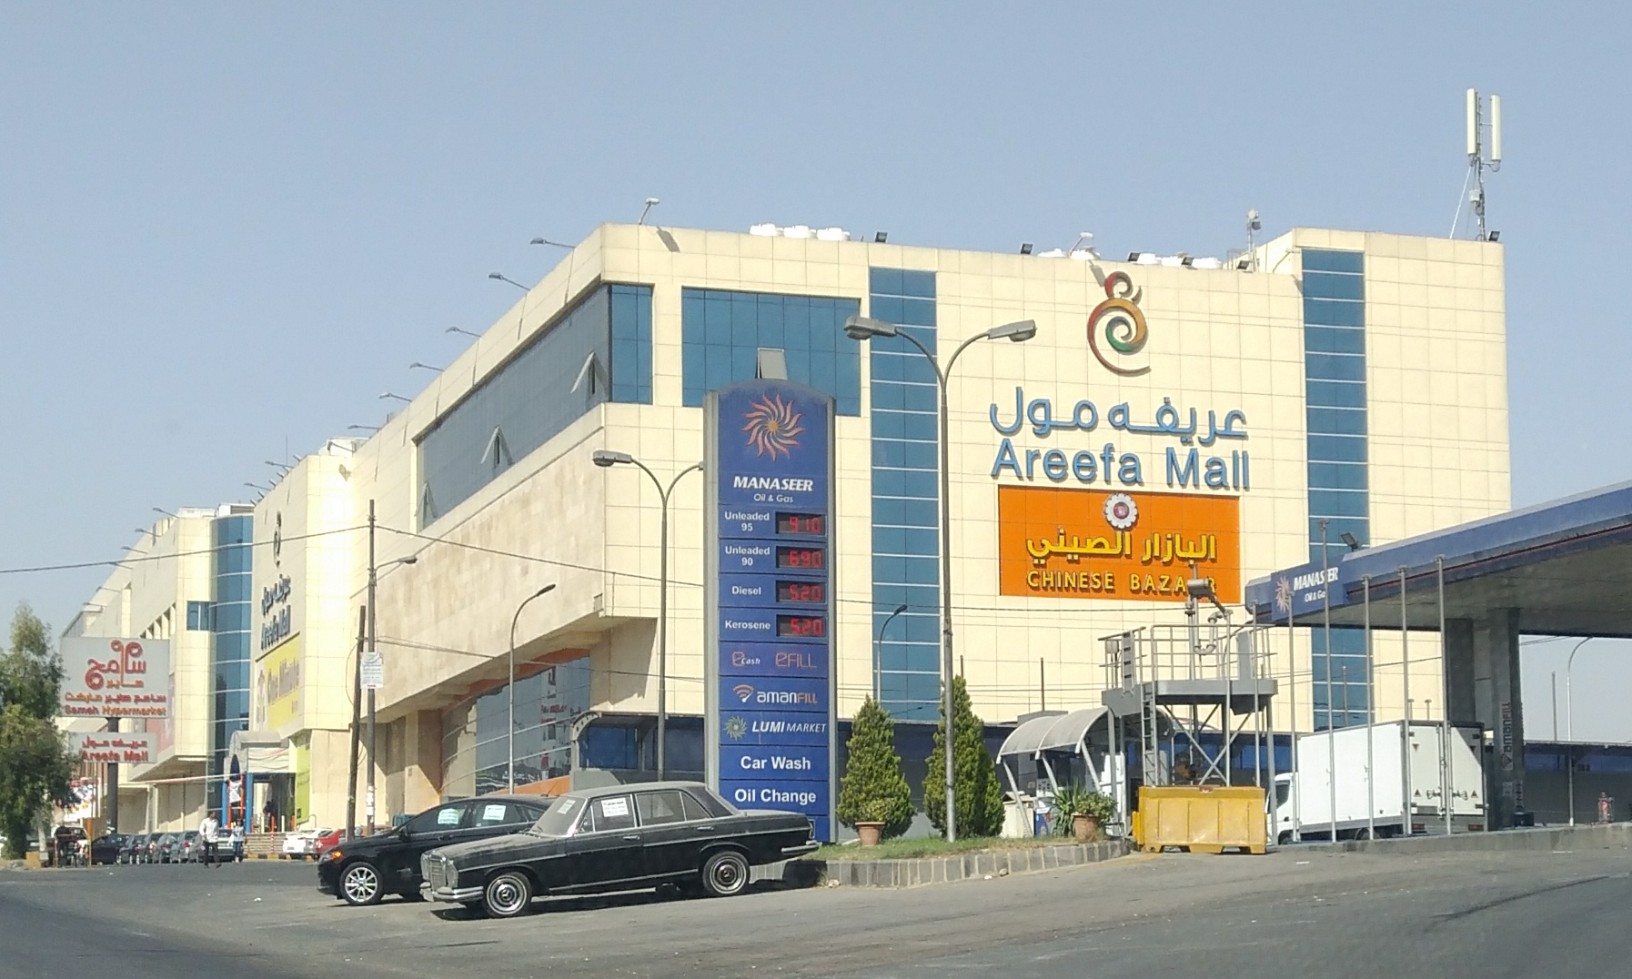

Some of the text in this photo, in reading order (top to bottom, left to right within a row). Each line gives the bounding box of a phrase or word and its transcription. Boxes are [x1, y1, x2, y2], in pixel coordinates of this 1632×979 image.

[990, 386, 1248, 445] عريفه مول
[991, 438, 1250, 490] Areefa Mall
[733, 476, 813, 491] MANASEER
[753, 494, 794, 503] Oil & Gas
[724, 511, 770, 521] Unleaded
[741, 522, 753, 532] 95
[724, 546, 771, 556] Unleaded
[1026, 528, 1217, 565] البازار الصيني
[741, 551, 822, 567] 90 690
[1027, 570, 1217, 595] CHINESE BAZAR
[731, 585, 823, 602] Diesel 520
[724, 618, 824, 635] Kerosene 520
[752, 721, 827, 733] LUMI MARKET
[741, 756, 811, 770] Car Wash
[734, 789, 817, 805] Oil Change
